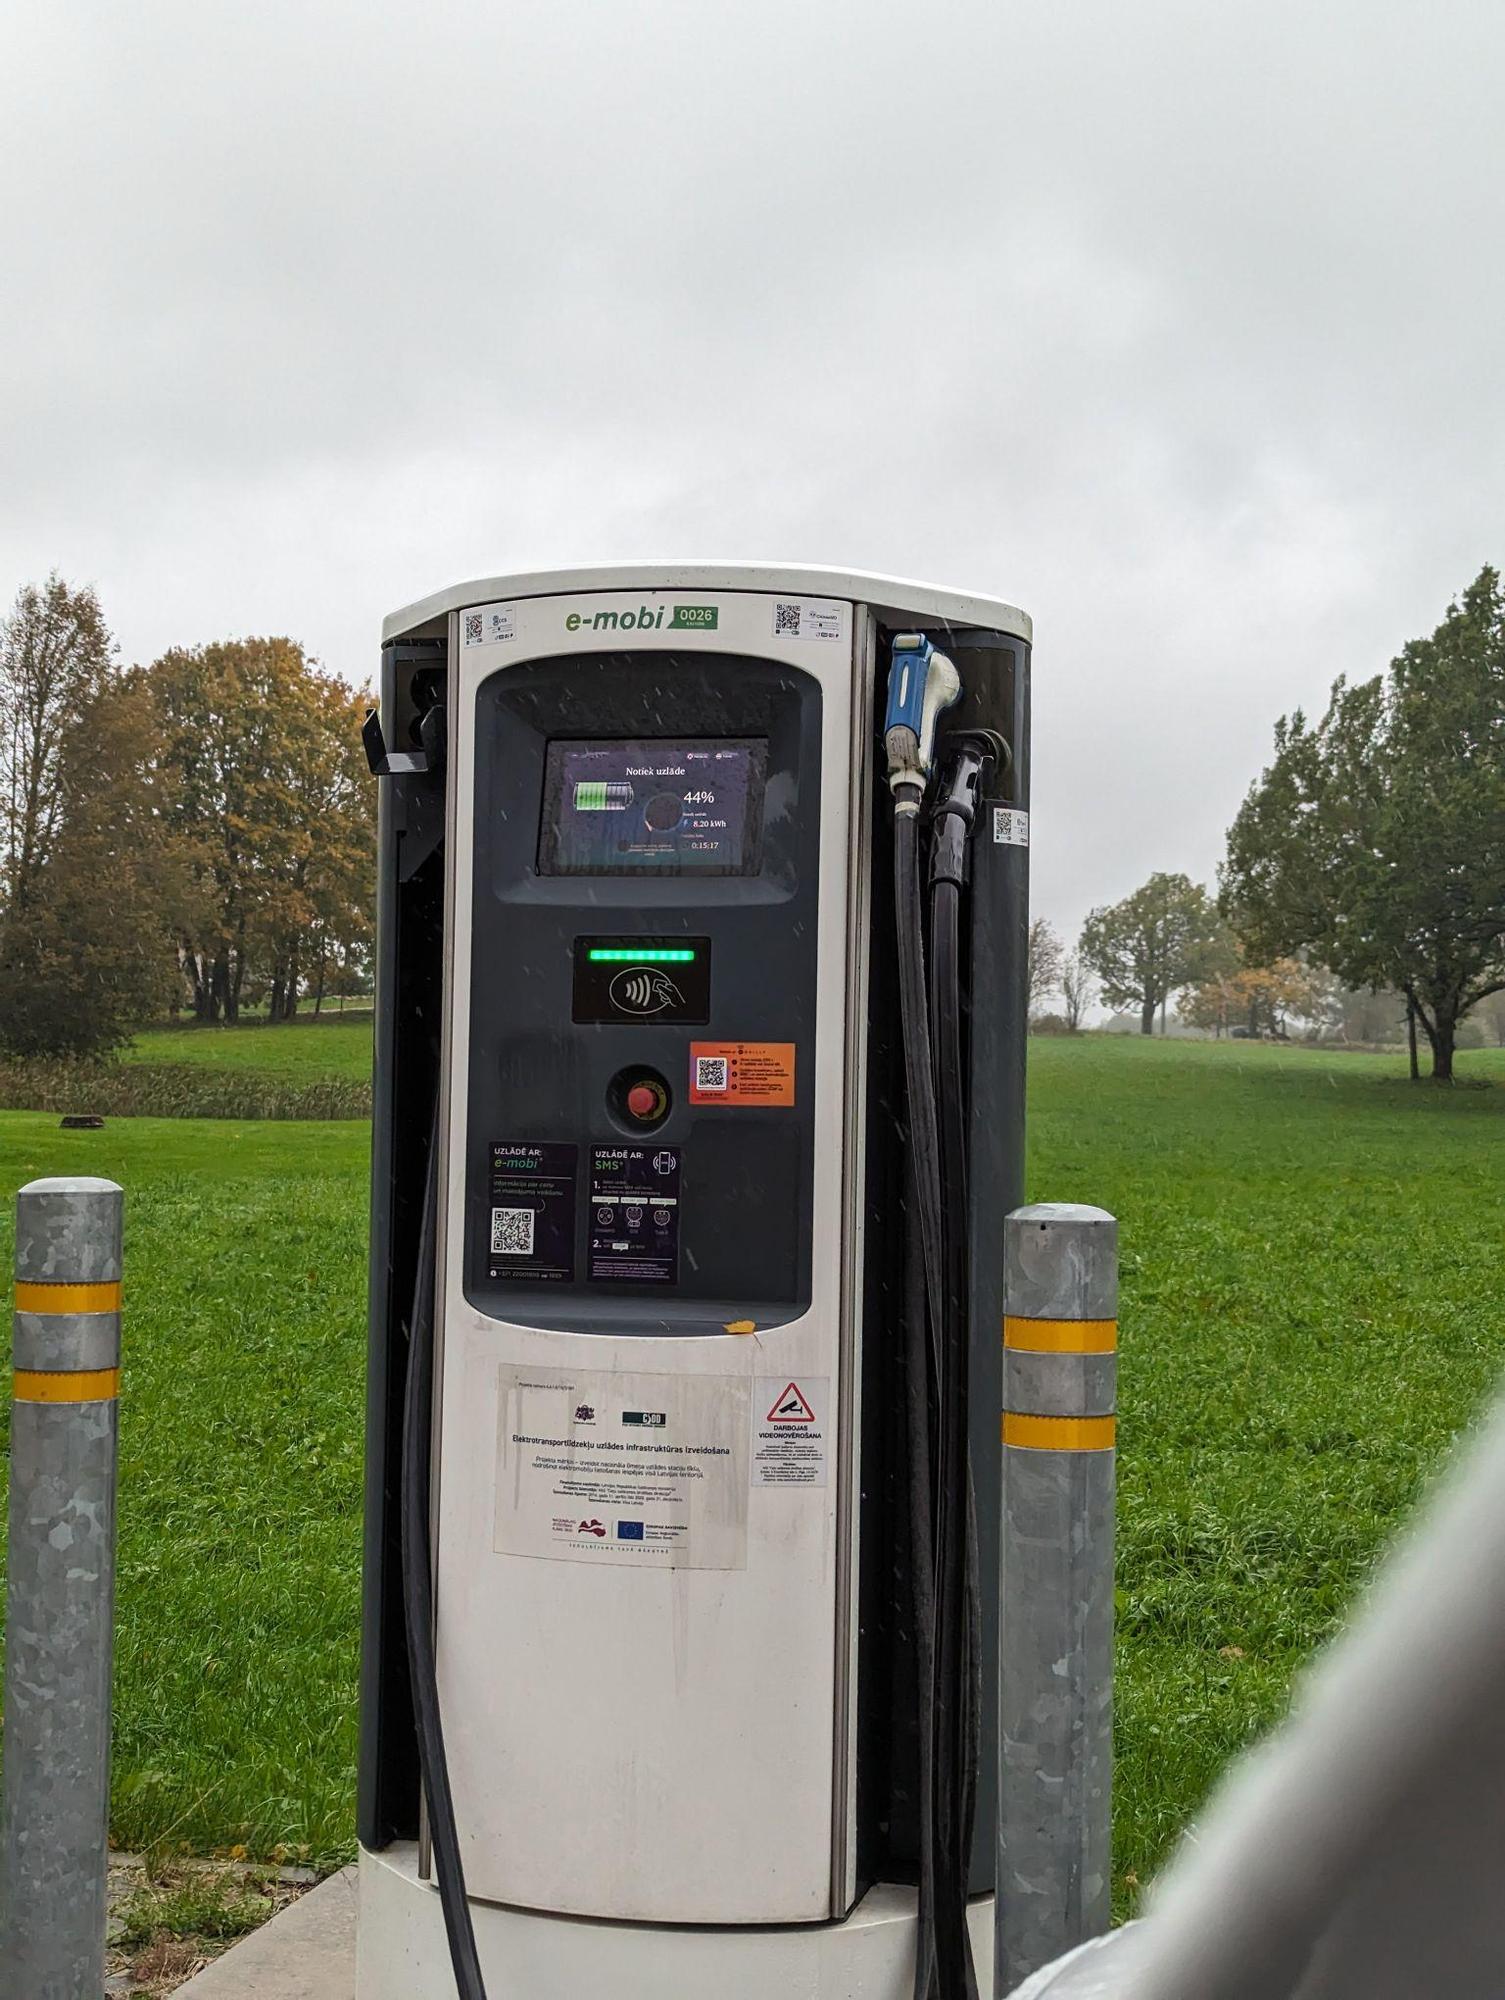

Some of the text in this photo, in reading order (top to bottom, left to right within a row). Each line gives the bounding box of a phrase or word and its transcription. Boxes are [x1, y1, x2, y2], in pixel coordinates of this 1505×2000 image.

[565, 605, 665, 632] e-mobi
[679, 609, 713, 621] 0026
[626, 766, 686, 776] Notiek uzlāde
[683, 791, 715, 804] 44%
[693, 820, 727, 828] 8.20 kWh
[494, 1146, 527, 1156] UZLĀDĒ
[595, 1149, 645, 1159] UZLĀDĒ AR:
[593, 1180, 601, 1189] 1.
[592, 1239, 602, 1248] 2.
[596, 1442, 624, 1451] uzlādes
[626, 1443, 684, 1454] infrastruktūras
[685, 1445, 730, 1455] izveidošana
